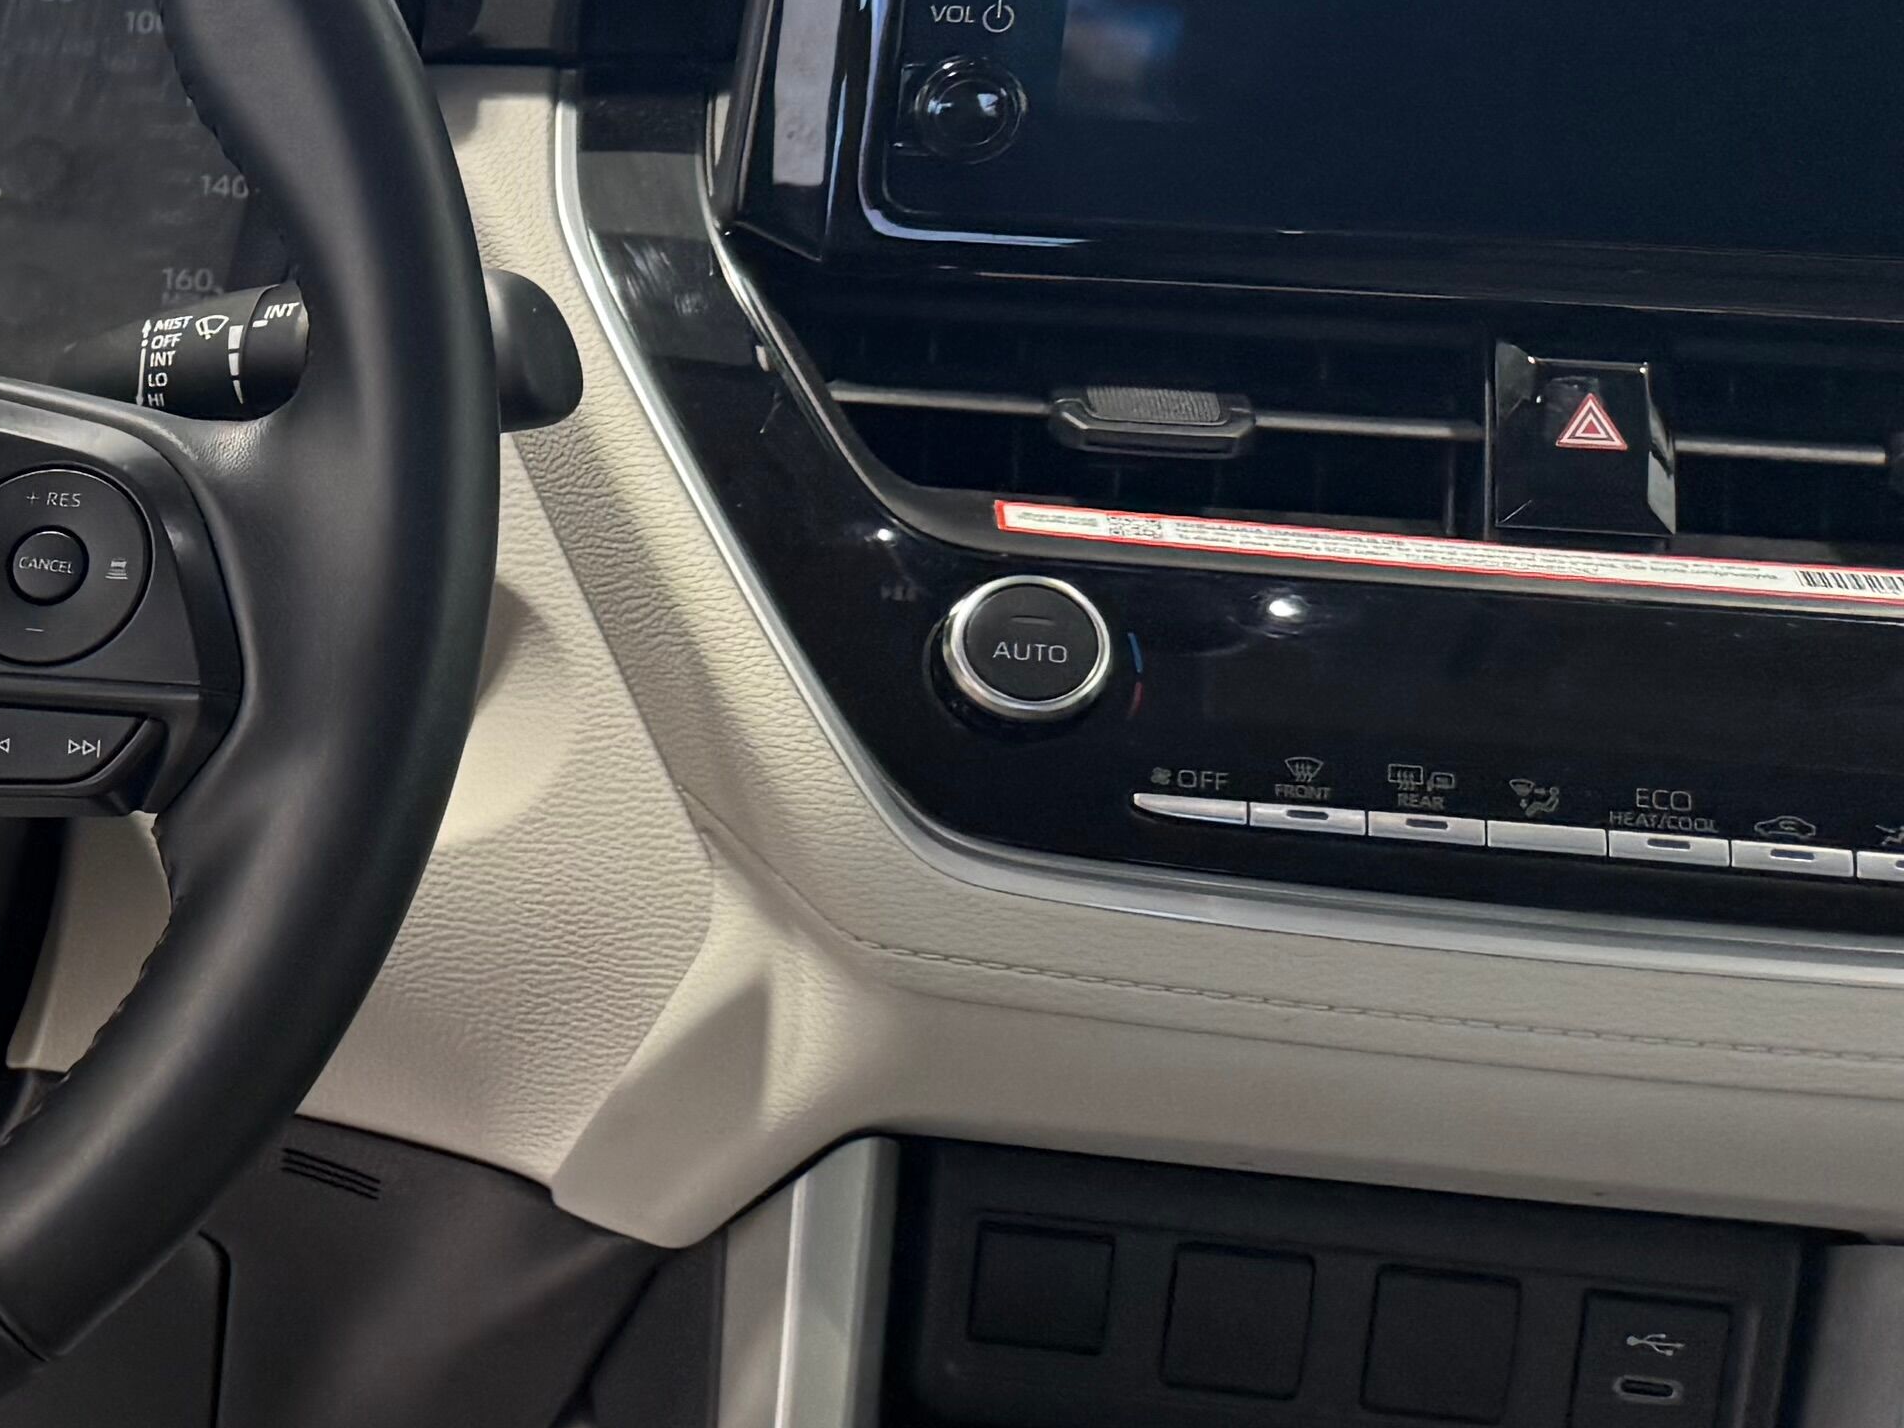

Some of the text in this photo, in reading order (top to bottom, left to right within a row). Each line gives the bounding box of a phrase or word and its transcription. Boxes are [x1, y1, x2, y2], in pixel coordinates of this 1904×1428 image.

[930, 4, 975, 24] VOL
[201, 175, 249, 198] 140
[161, 267, 214, 292] 160
[264, 303, 300, 319] INT
[154, 316, 193, 332] MIST
[151, 333, 182, 350] OFF
[150, 351, 175, 367] INT
[148, 373, 168, 387] LO
[148, 394, 165, 407] HI
[46, 492, 81, 509] RES
[18, 556, 74, 575] CANCEL
[993, 639, 1068, 665] AUTO
[1177, 770, 1229, 791] OFF
[1275, 784, 1331, 801] FRONT
[1636, 788, 1692, 811] ECO
[1398, 793, 1445, 810] REAR
[1609, 811, 1719, 834] HEAT/COOL
